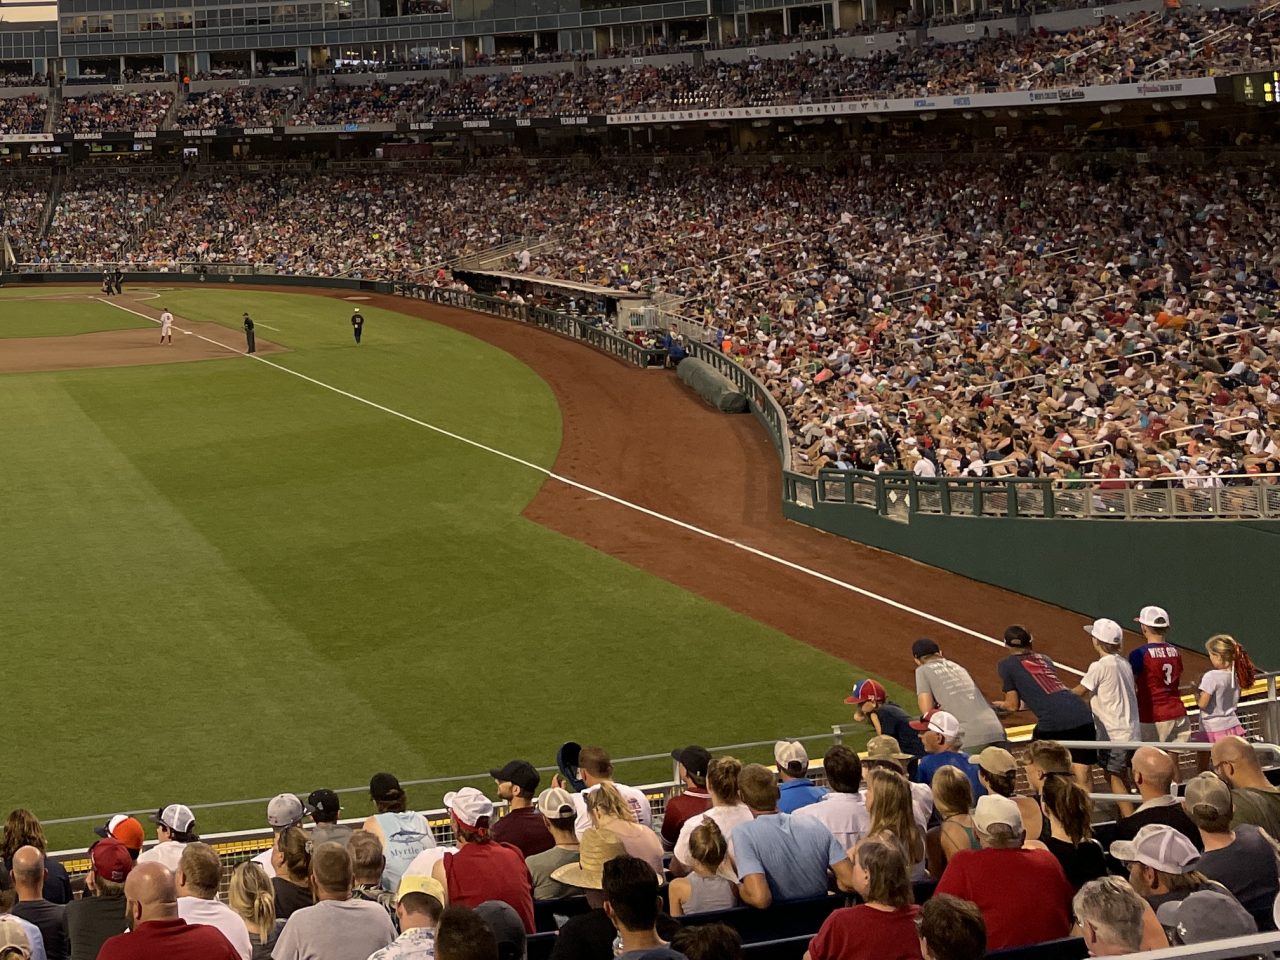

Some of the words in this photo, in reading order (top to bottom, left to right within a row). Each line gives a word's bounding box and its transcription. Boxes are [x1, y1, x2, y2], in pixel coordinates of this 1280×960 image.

[462, 120, 490, 128] STANFORD
[560, 117, 575, 125] TEXAS
[1148, 646, 1166, 658] WISE
[1162, 663, 1173, 686] 3
[390, 847, 419, 857] Myrtle
